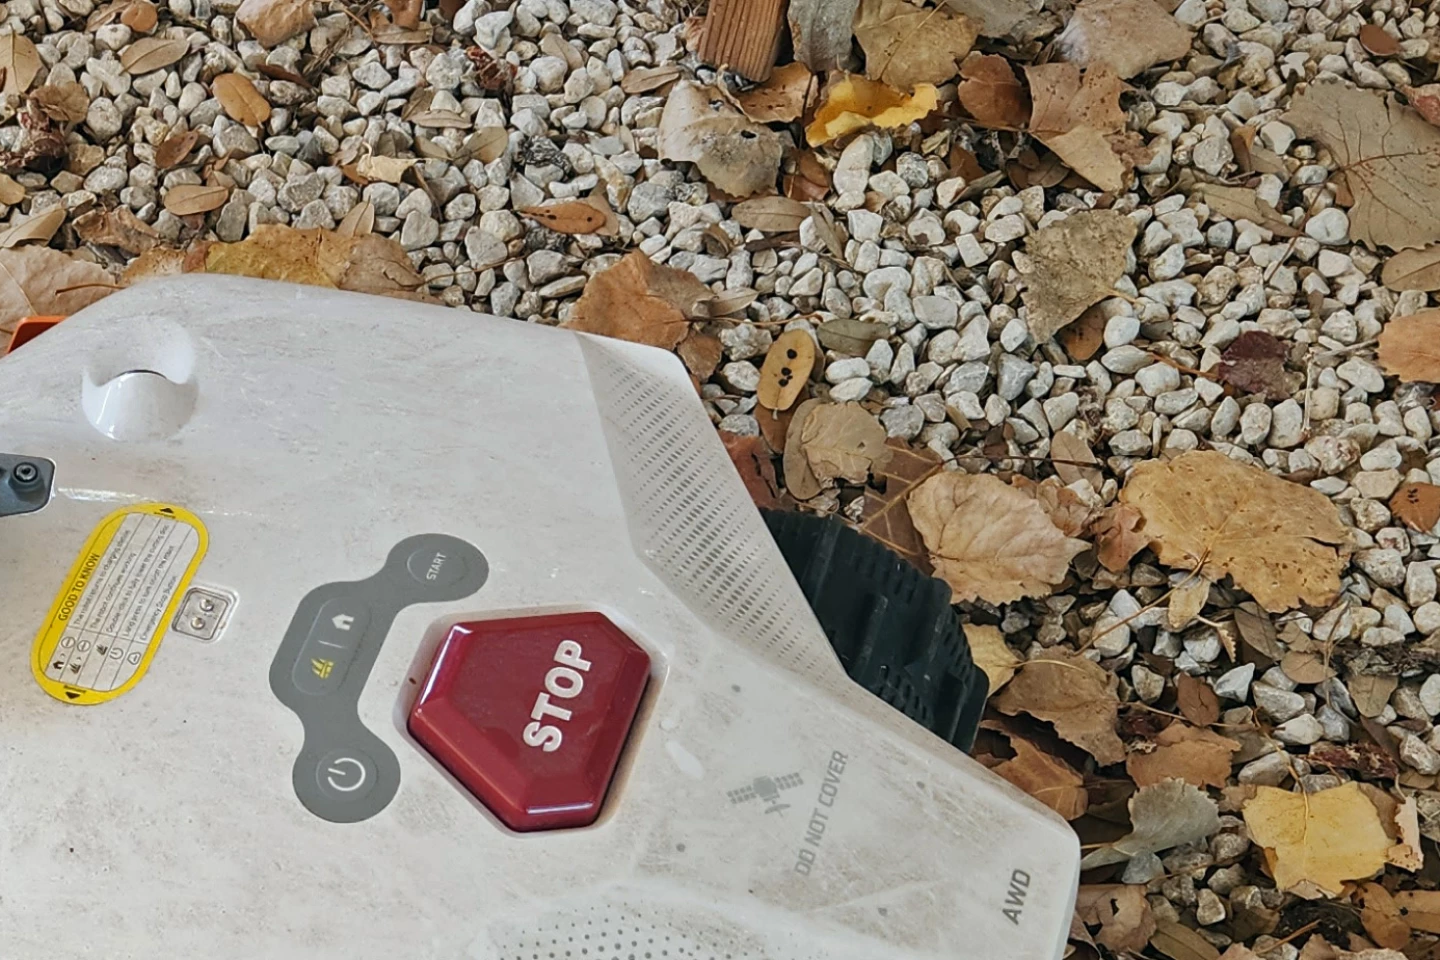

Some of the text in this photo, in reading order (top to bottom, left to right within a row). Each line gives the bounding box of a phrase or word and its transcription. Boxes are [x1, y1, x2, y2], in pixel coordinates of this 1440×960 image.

[58, 552, 100, 621] GOOD TO KNOW
[426, 551, 448, 581] START
[522, 638, 594, 753] STOP
[795, 749, 849, 877] DO NOT COVER
[1001, 867, 1031, 926] AWD
